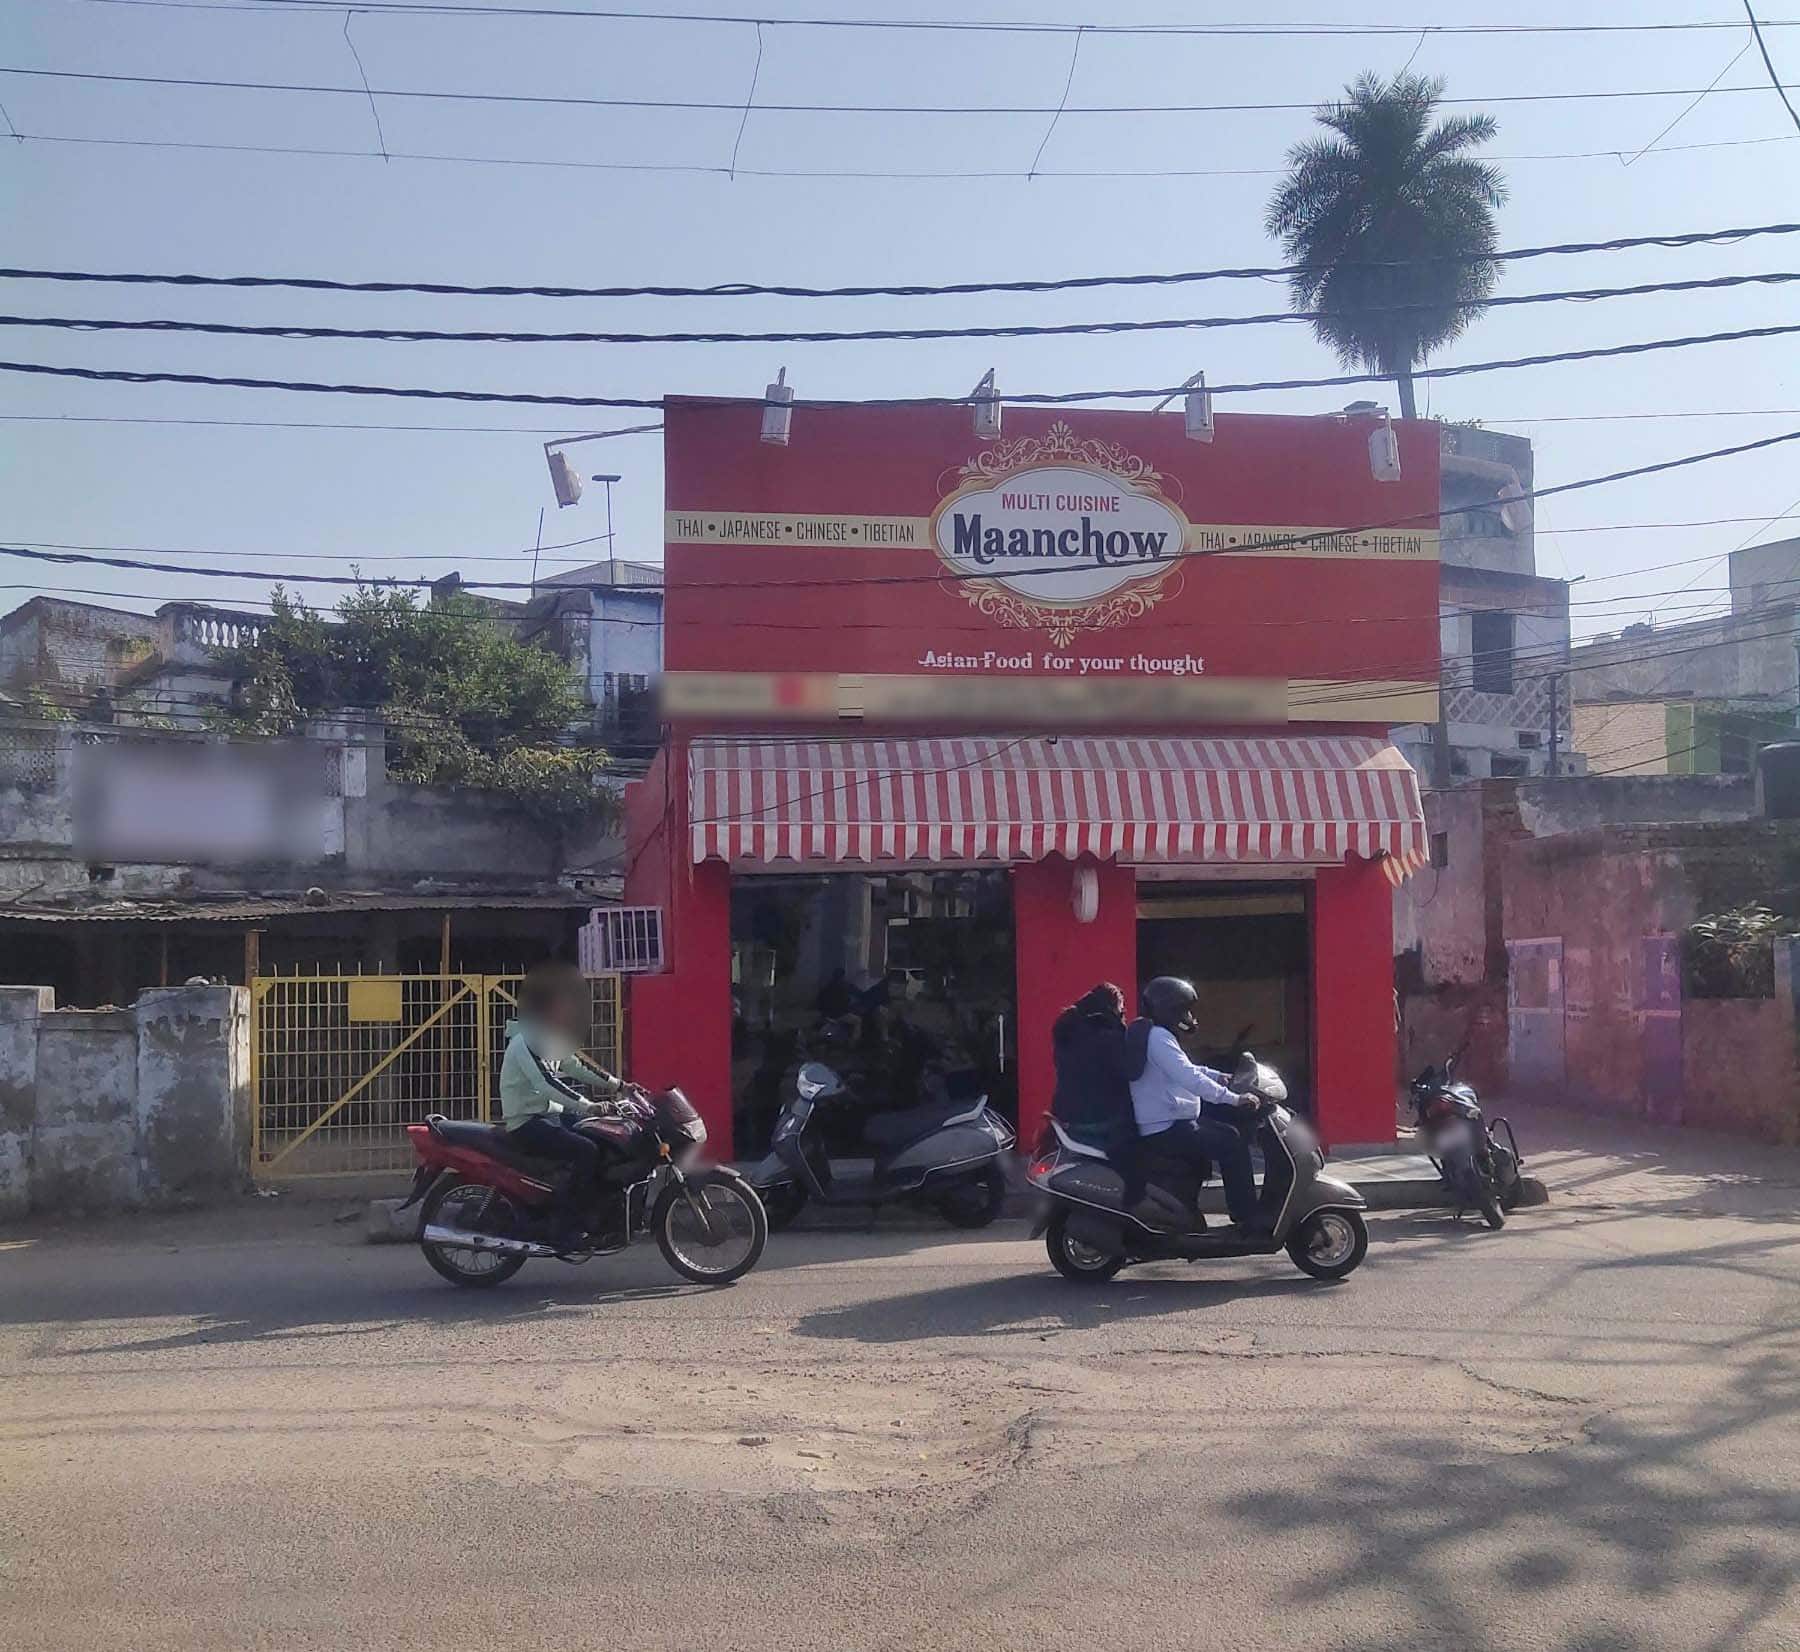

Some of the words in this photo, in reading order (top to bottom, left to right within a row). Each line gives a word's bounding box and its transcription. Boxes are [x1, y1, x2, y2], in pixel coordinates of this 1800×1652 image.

[1002, 494, 1050, 510] MULTI
[1056, 495, 1120, 512] CUISINE
[677, 519, 703, 537] THAI
[719, 521, 781, 539] JAPANESE
[797, 522, 847, 541] CHINESE
[863, 524, 914, 542] TIBETIAN
[953, 513, 1168, 564] Maanchow
[1200, 532, 1225, 550] THAI
[1311, 535, 1358, 552] CHINESE
[1372, 536, 1420, 553] TIBETIAN
[918, 650, 978, 667] Asian
[979, 651, 1032, 668] Food
[1043, 652, 1074, 669] for
[1079, 656, 1124, 674] your
[1130, 654, 1205, 675] thought
